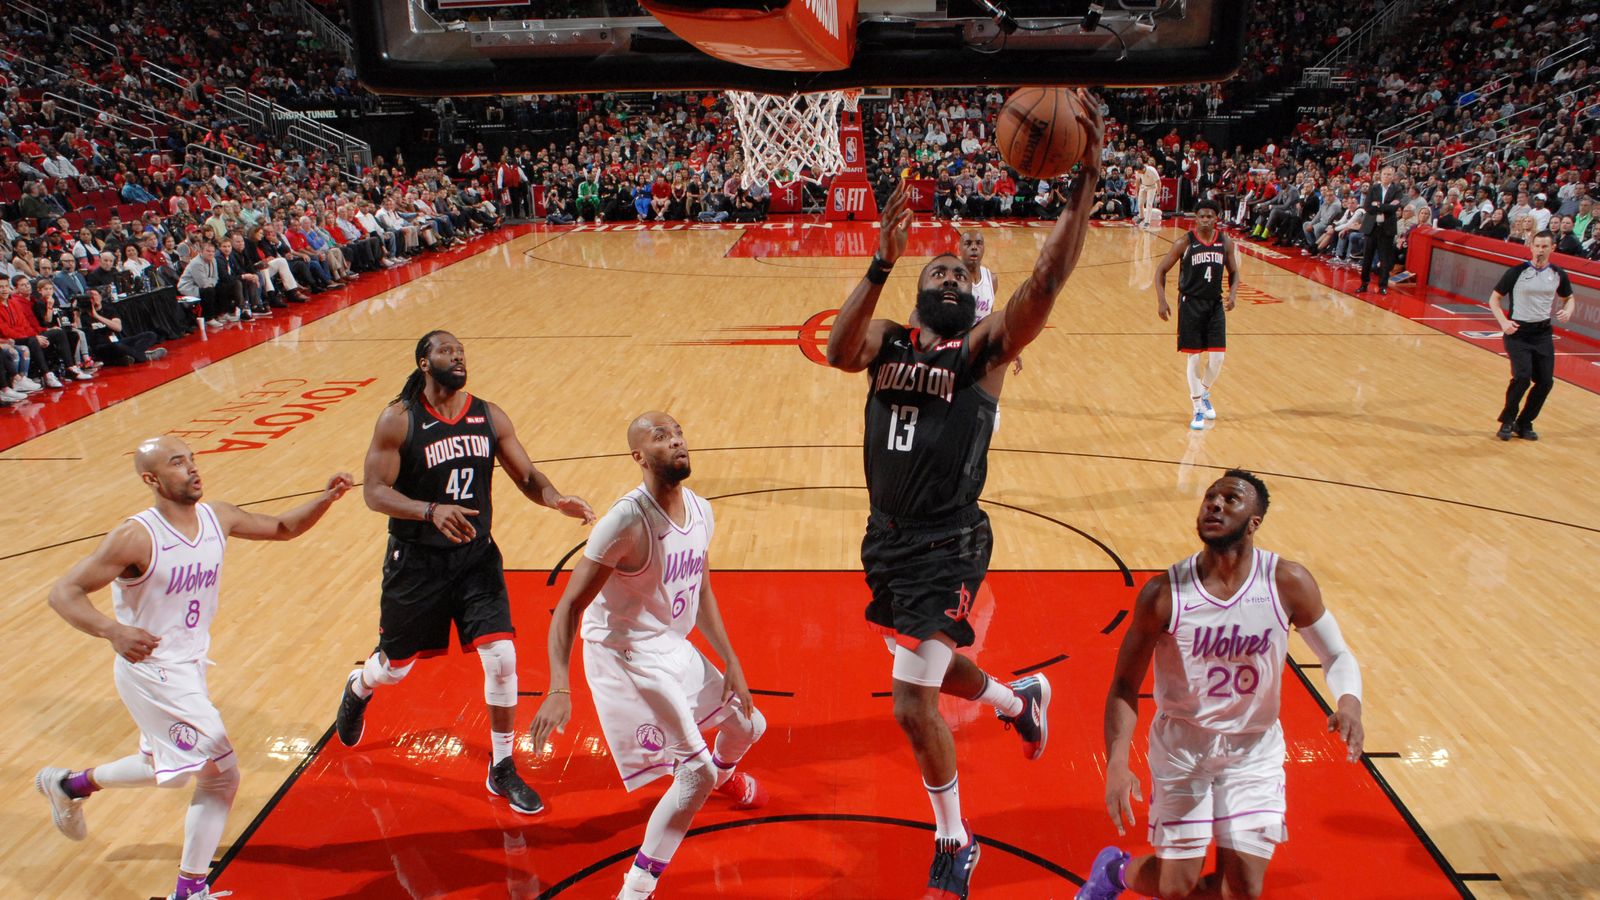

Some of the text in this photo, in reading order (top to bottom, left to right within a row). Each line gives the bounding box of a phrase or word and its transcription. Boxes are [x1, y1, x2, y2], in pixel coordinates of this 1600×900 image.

[306, 109, 338, 119] TUNNEL
[846, 187, 868, 212] FIT
[570, 223, 833, 233] HOUSTON
[1191, 251, 1224, 266] HOUSTON
[1203, 266, 1212, 283] 4
[875, 362, 955, 403] HOUSTON
[162, 378, 308, 447] CENTE
[195, 377, 378, 455] TOYOTA
[887, 404, 919, 452] 13
[424, 434, 490, 469] HOUSTON
[445, 467, 475, 500] 42
[165, 562, 219, 595] Wolves
[185, 599, 200, 629] 8
[672, 583, 697, 619] 67
[1191, 624, 1273, 662] Wolves
[1207, 664, 1260, 698] 20
